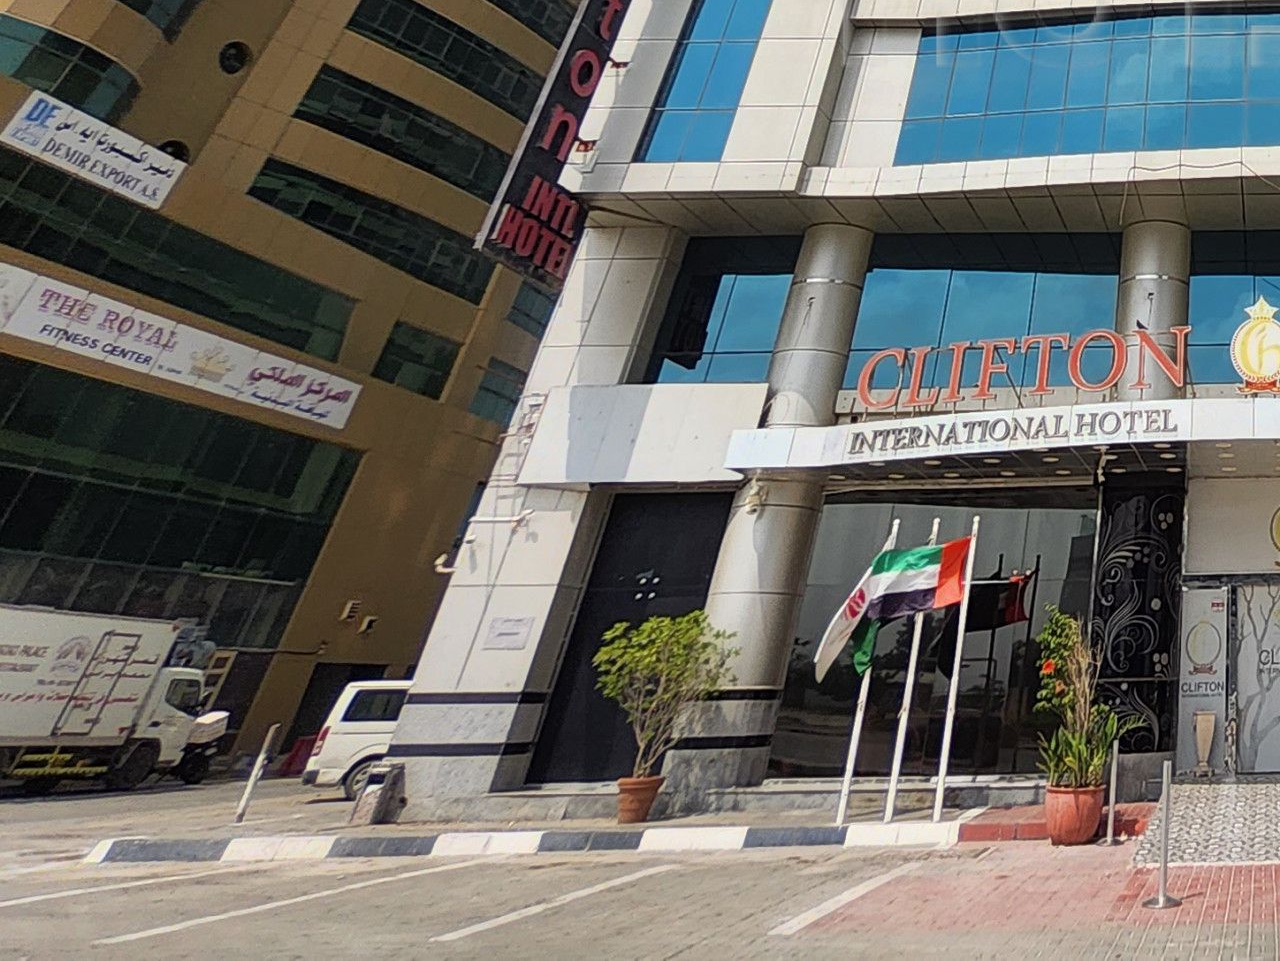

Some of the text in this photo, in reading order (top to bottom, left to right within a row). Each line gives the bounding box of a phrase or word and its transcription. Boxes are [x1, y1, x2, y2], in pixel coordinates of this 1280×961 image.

[42, 138, 91, 172] DEMIR
[88, 160, 142, 191] EXPORT
[37, 288, 179, 352] THE ROYAL
[39, 324, 153, 366] FITNESS CENTER
[857, 325, 1192, 410] CLIFTON
[848, 409, 1178, 455] INTERNATIONAL HOTEL
[1181, 681, 1225, 693] CLIFTON
